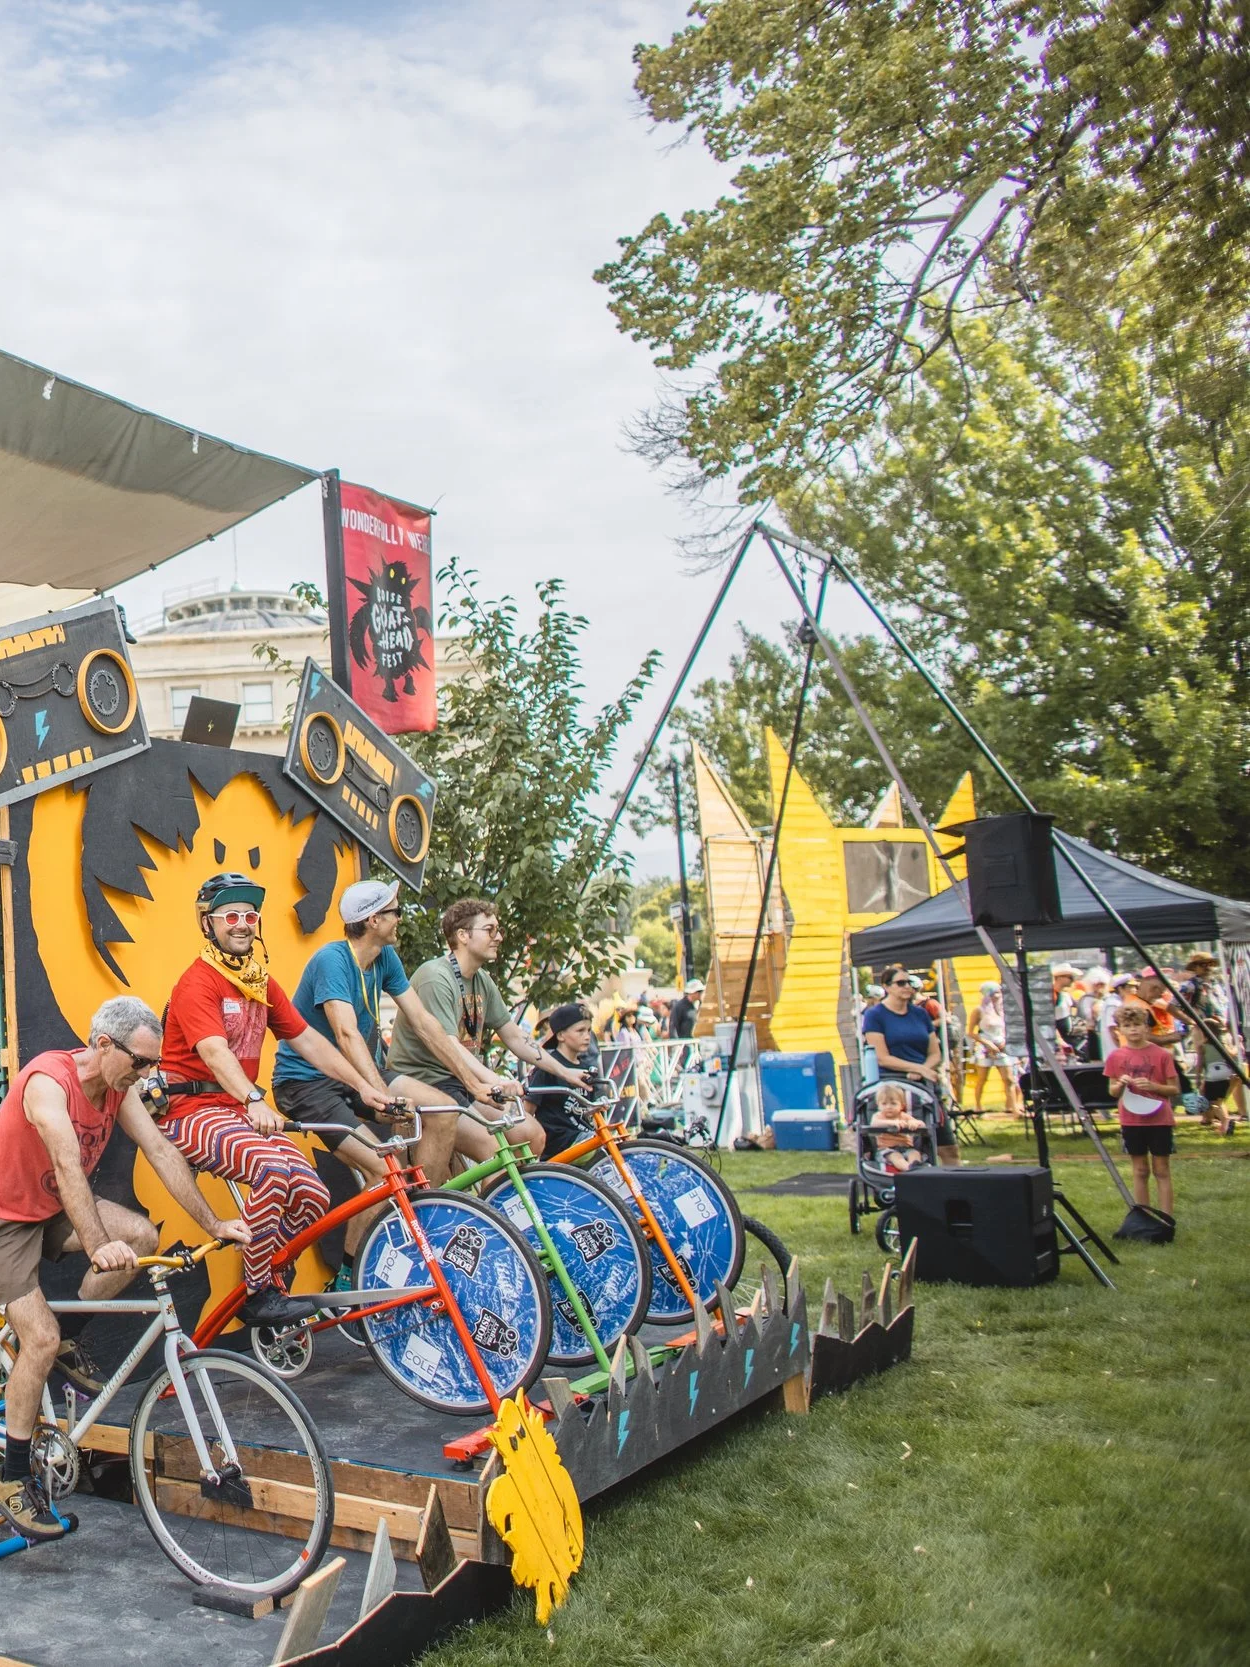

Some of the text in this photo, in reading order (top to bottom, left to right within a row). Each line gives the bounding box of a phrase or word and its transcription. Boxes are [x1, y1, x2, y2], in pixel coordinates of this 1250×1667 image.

[341, 508, 404, 547] WONDERFULLY
[376, 585, 402, 605] BOISE
[371, 603, 406, 634] GOAT
[377, 625, 414, 652] HEAD
[381, 651, 403, 668] FEST
[689, 1190, 711, 1219] COLE
[420, 1242, 435, 1261] BIKE
[573, 1231, 592, 1259] BOISE
[380, 1249, 398, 1281] COLE
[444, 1250, 473, 1271] BOISE
[472, 1313, 493, 1341] BOISE
[405, 1350, 435, 1376] COLE
